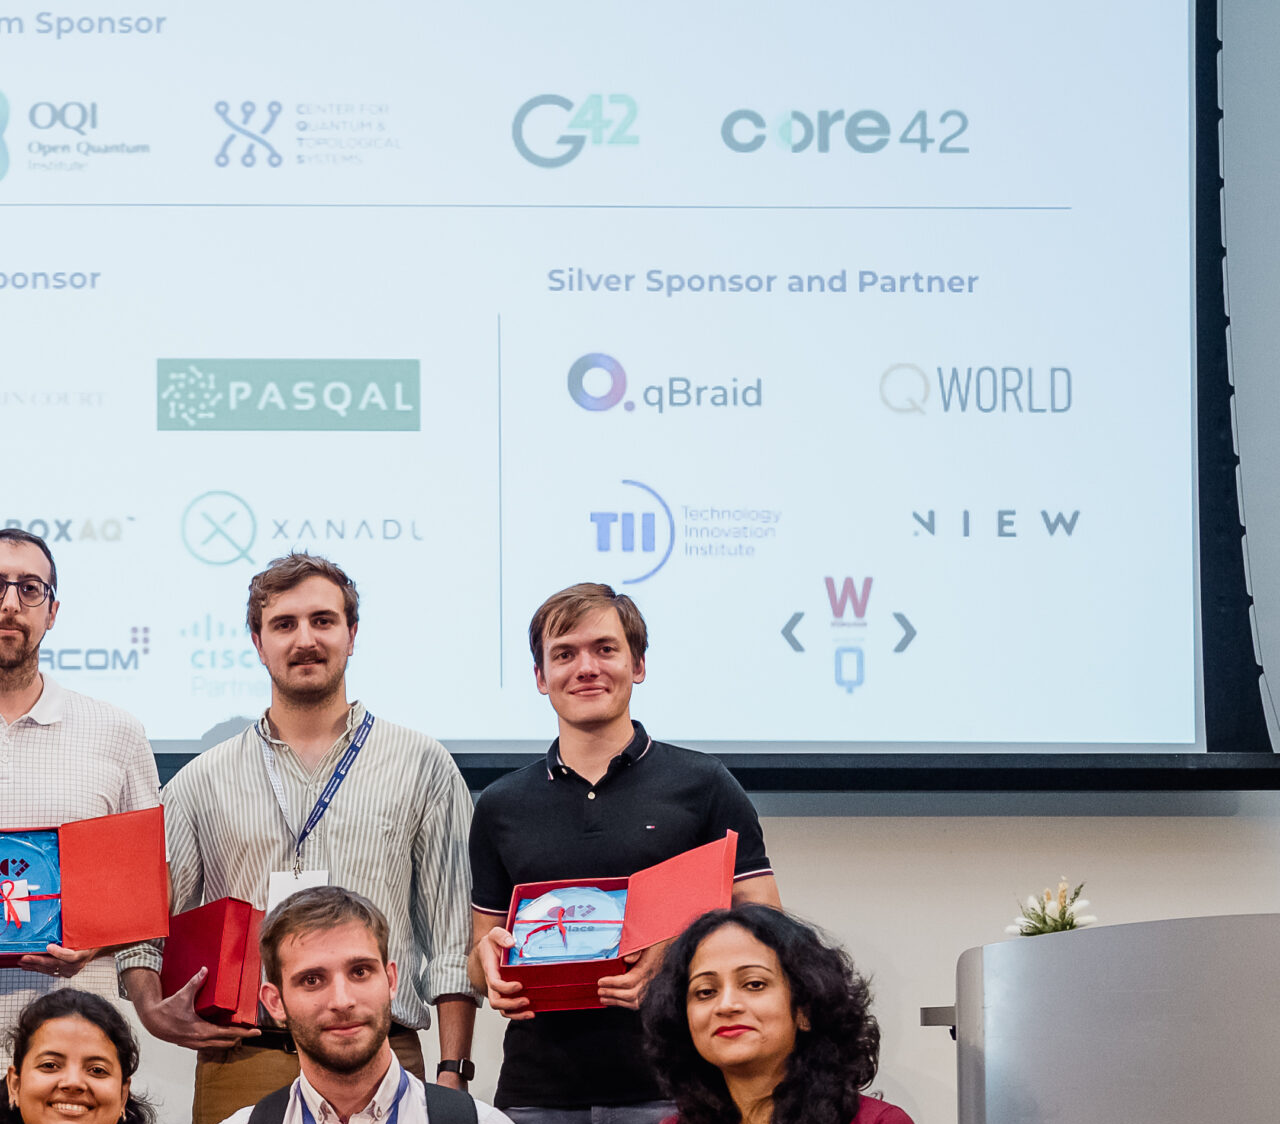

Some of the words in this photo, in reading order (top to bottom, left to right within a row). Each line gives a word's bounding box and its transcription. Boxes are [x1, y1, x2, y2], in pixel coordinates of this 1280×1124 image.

[34, 12, 168, 40] Sponsor
[28, 101, 98, 136] OQI
[511, 93, 641, 169] G42
[27, 141, 71, 157] Open
[76, 141, 151, 157] Quantum
[546, 267, 636, 293] Silver
[644, 267, 778, 298] Sponsor
[786, 269, 848, 294] and
[857, 269, 980, 295] Partner
[228, 380, 413, 417] PASQAL
[642, 376, 763, 414] qBraid
[681, 504, 783, 526] Technology
[911, 508, 1081, 539] NIEW
[589, 511, 656, 553] TII
[684, 522, 777, 541] Innovation
[684, 541, 757, 559] Institute
[190, 649, 256, 670] CISC
